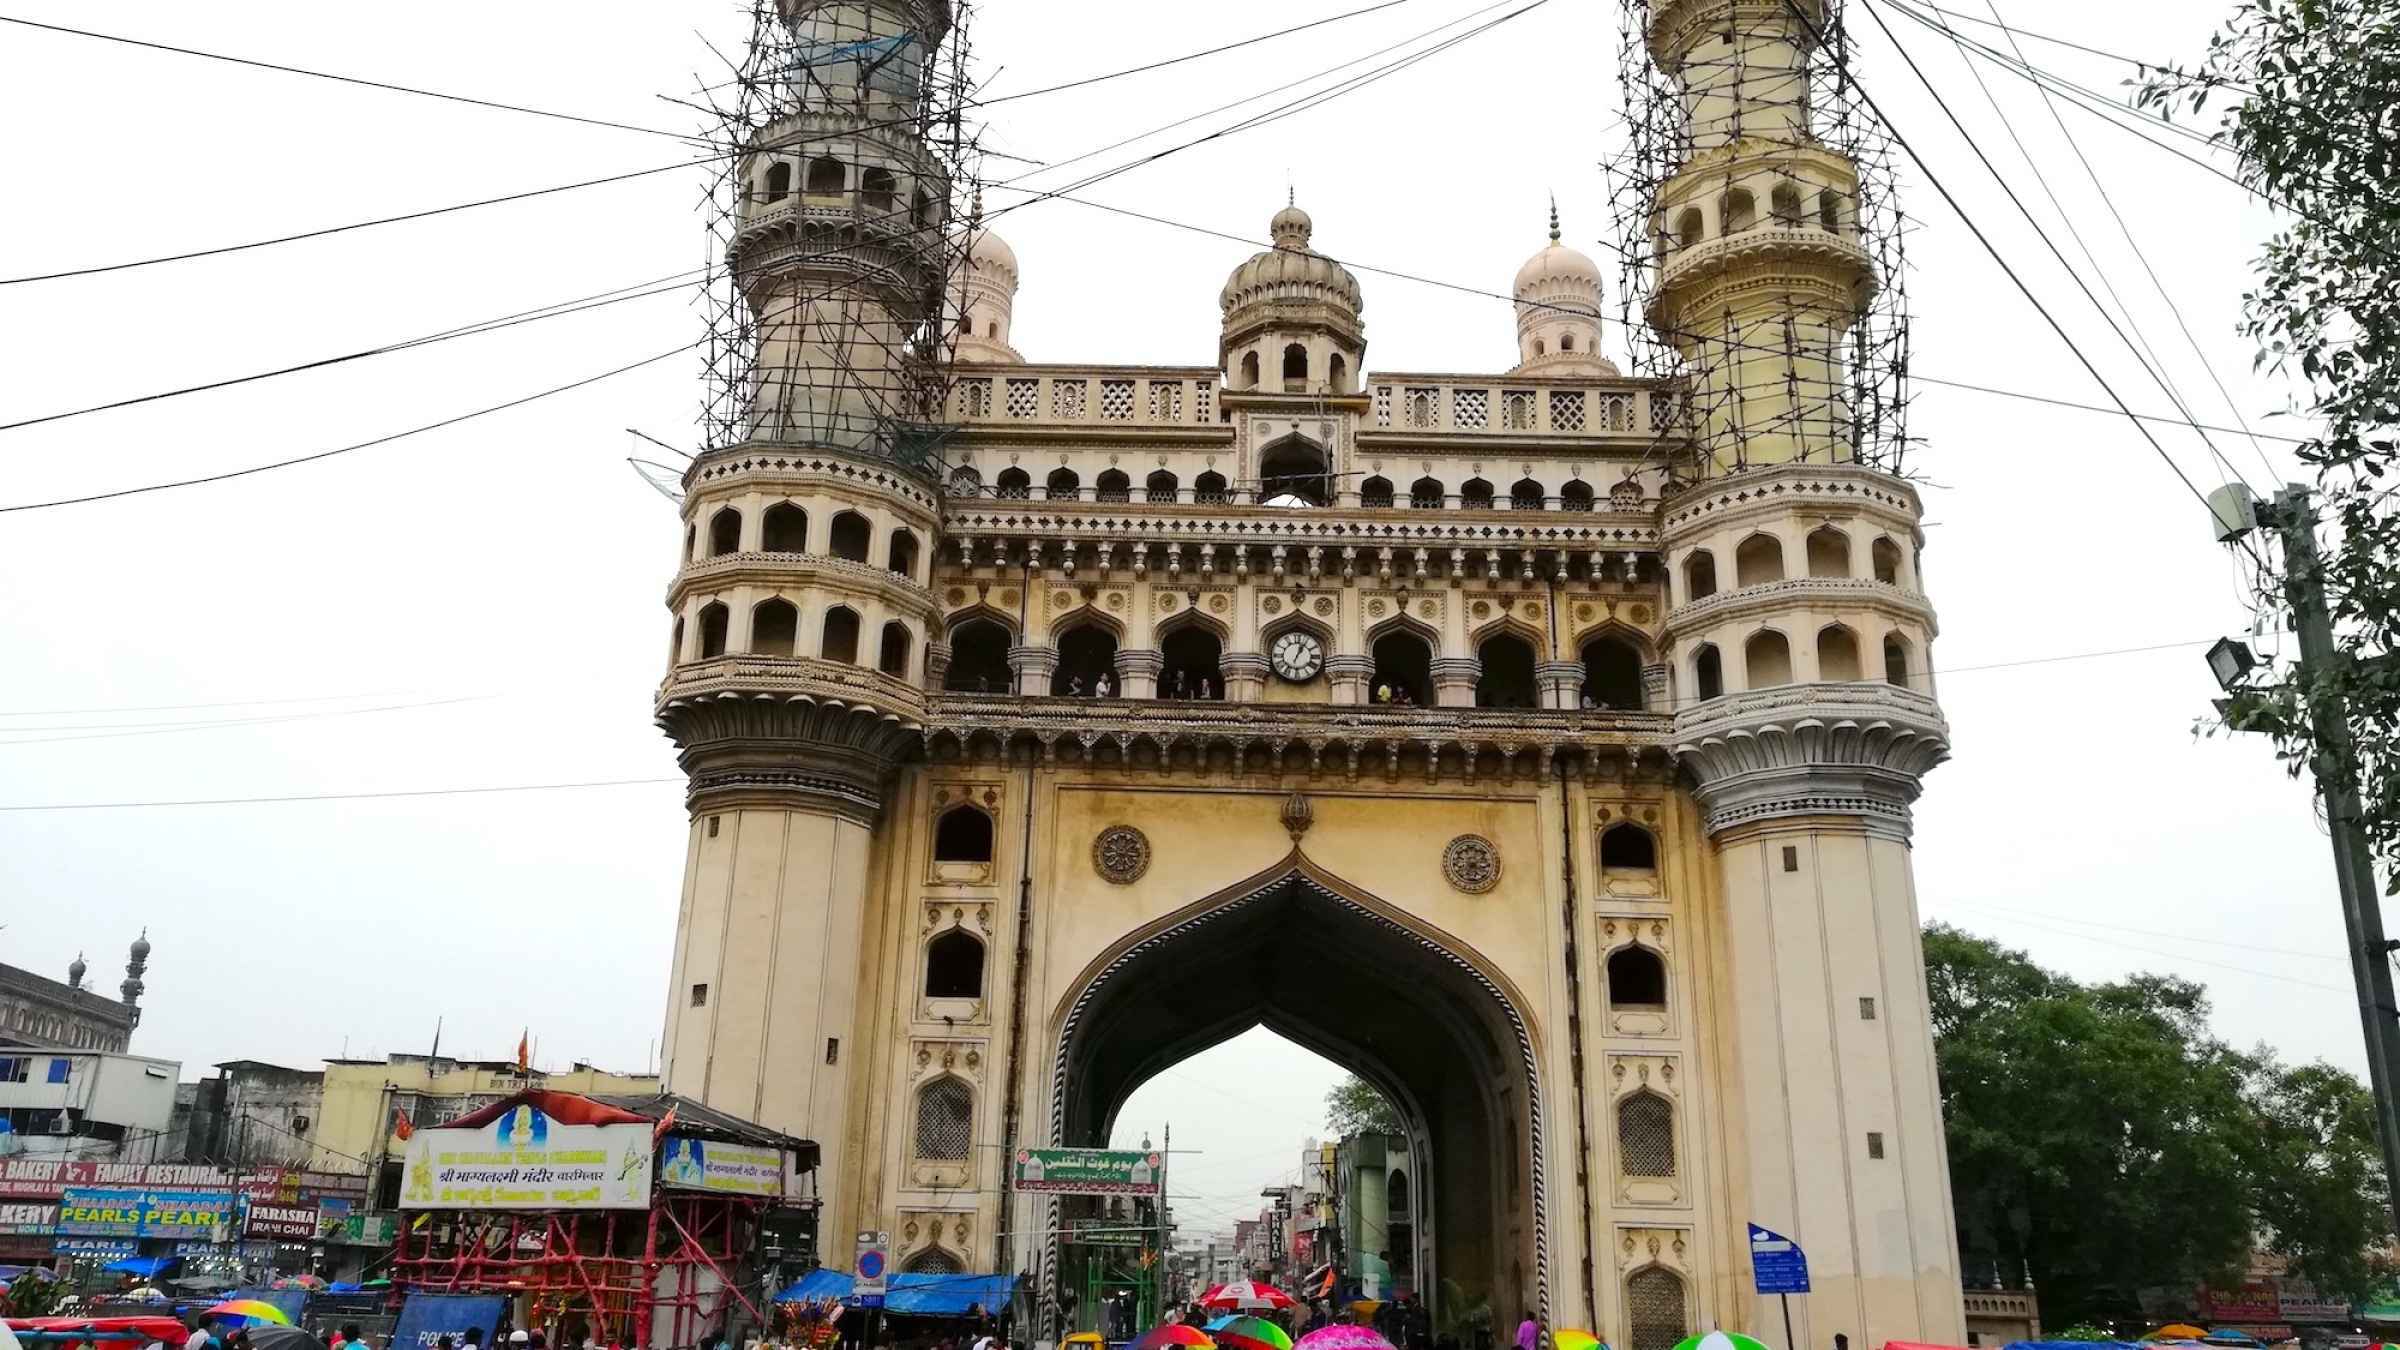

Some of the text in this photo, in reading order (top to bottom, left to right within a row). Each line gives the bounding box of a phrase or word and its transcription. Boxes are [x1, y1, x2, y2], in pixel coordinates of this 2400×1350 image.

[5, 1160, 63, 1180] BAKERY
[94, 1162, 146, 1183] FAMILY
[61, 1207, 140, 1223] PEARLS
[144, 1210, 242, 1225] PEARL
[251, 1206, 315, 1224] FARASHA
[283, 1223, 310, 1236] CHAI
[56, 1240, 135, 1249] PEARLS
[176, 1243, 240, 1255] PEARS
[417, 1331, 465, 1347] POLCE
